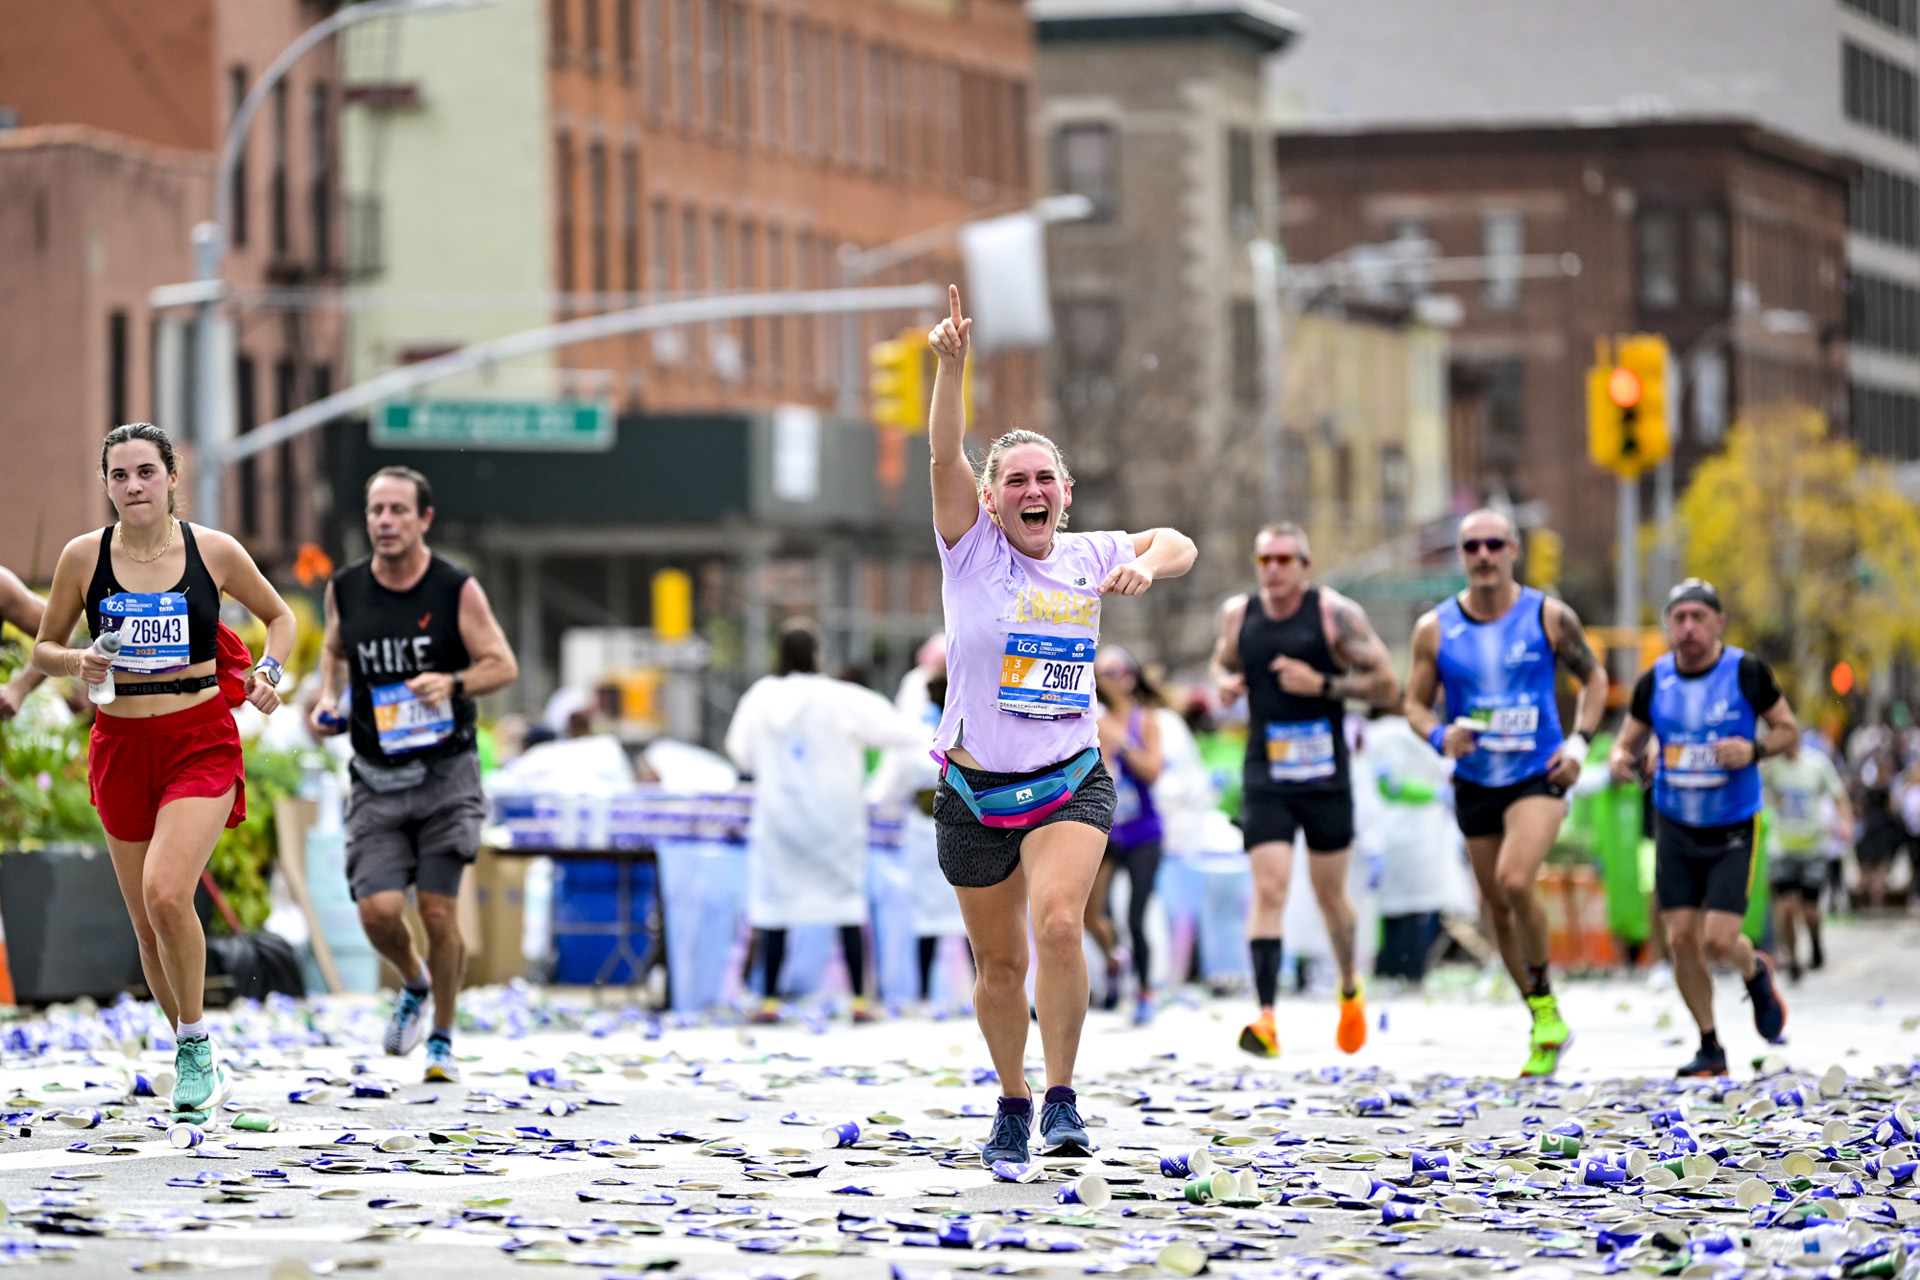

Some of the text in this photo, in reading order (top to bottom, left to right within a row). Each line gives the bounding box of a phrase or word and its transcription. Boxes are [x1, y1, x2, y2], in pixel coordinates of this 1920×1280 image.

[107, 618, 113, 627] 3
[131, 618, 181, 644] 26943
[1017, 639, 1038, 653] tcs
[135, 648, 157, 656] 2022
[357, 635, 433, 675] MIKE
[1014, 659, 1022, 668] 3
[1011, 673, 1021, 683] B
[1042, 662, 1085, 690] 29617
[1041, 693, 1061, 701] 2022
